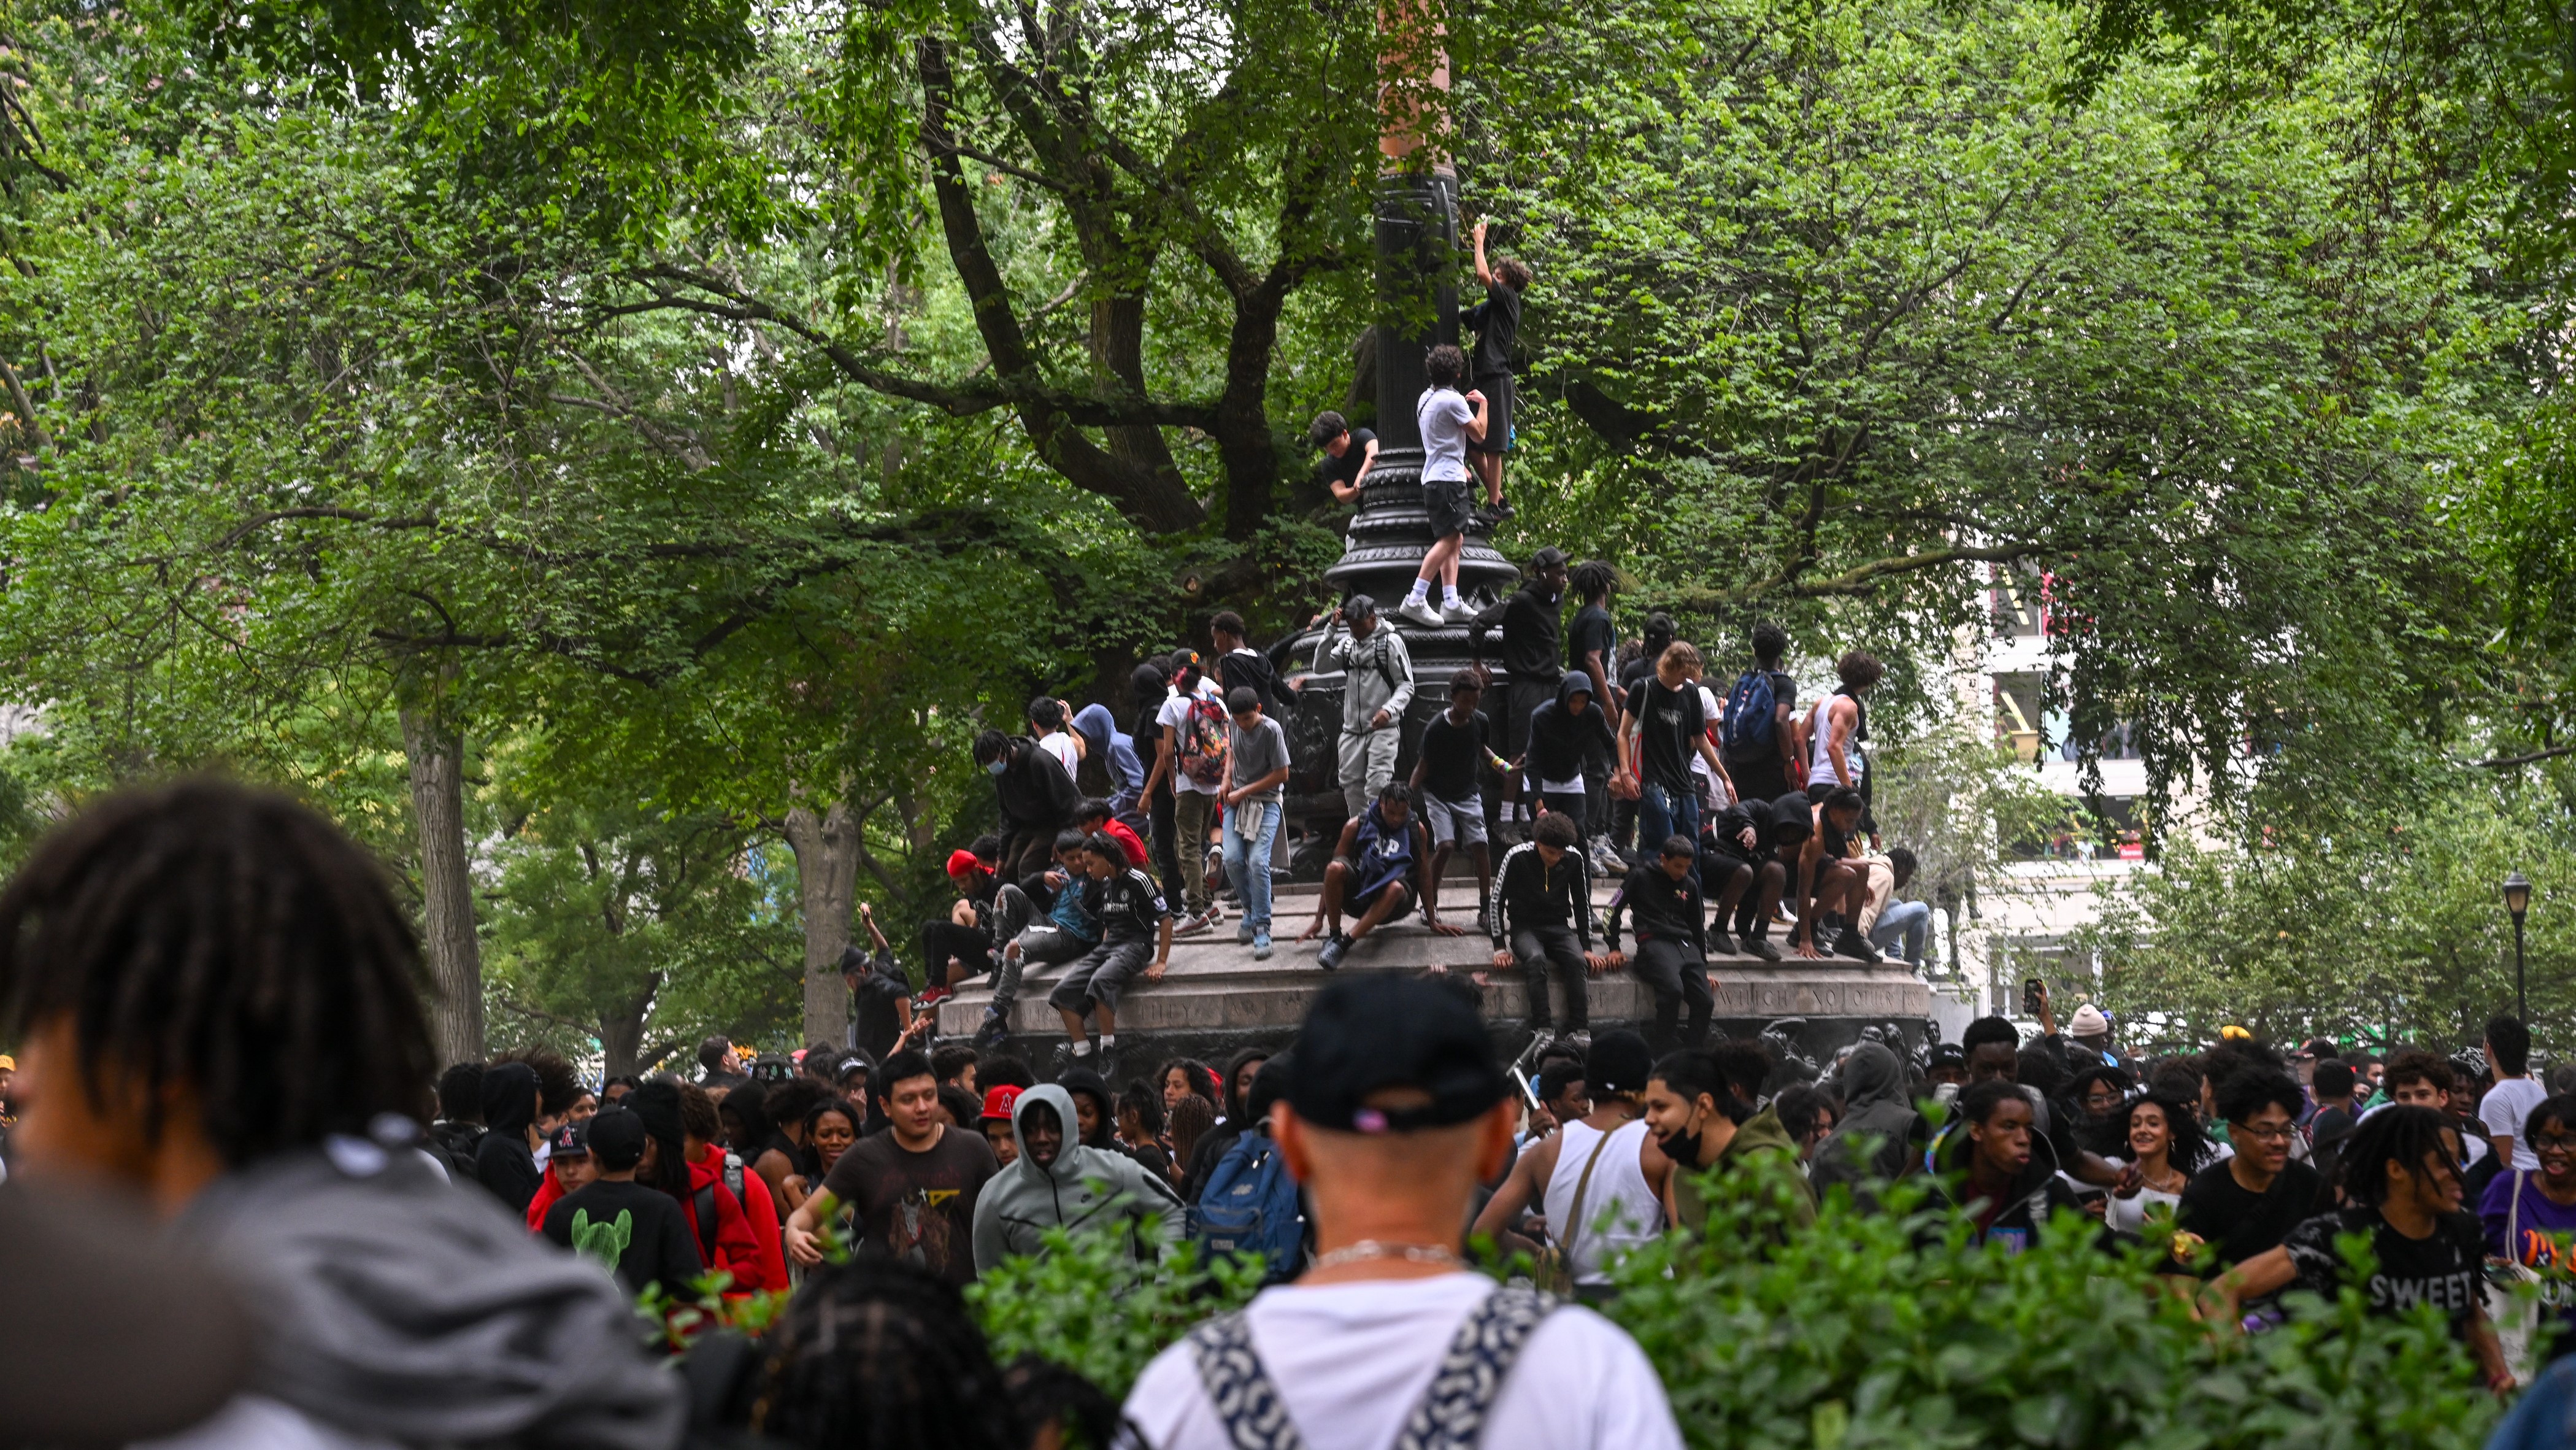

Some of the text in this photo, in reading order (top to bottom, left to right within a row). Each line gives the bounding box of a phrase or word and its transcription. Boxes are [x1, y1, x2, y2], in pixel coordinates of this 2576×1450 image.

[1103, 902, 1129, 913] AMSUNG
[1720, 989, 1788, 1007] WHICH
[2369, 1271, 2471, 1311] SWEET
